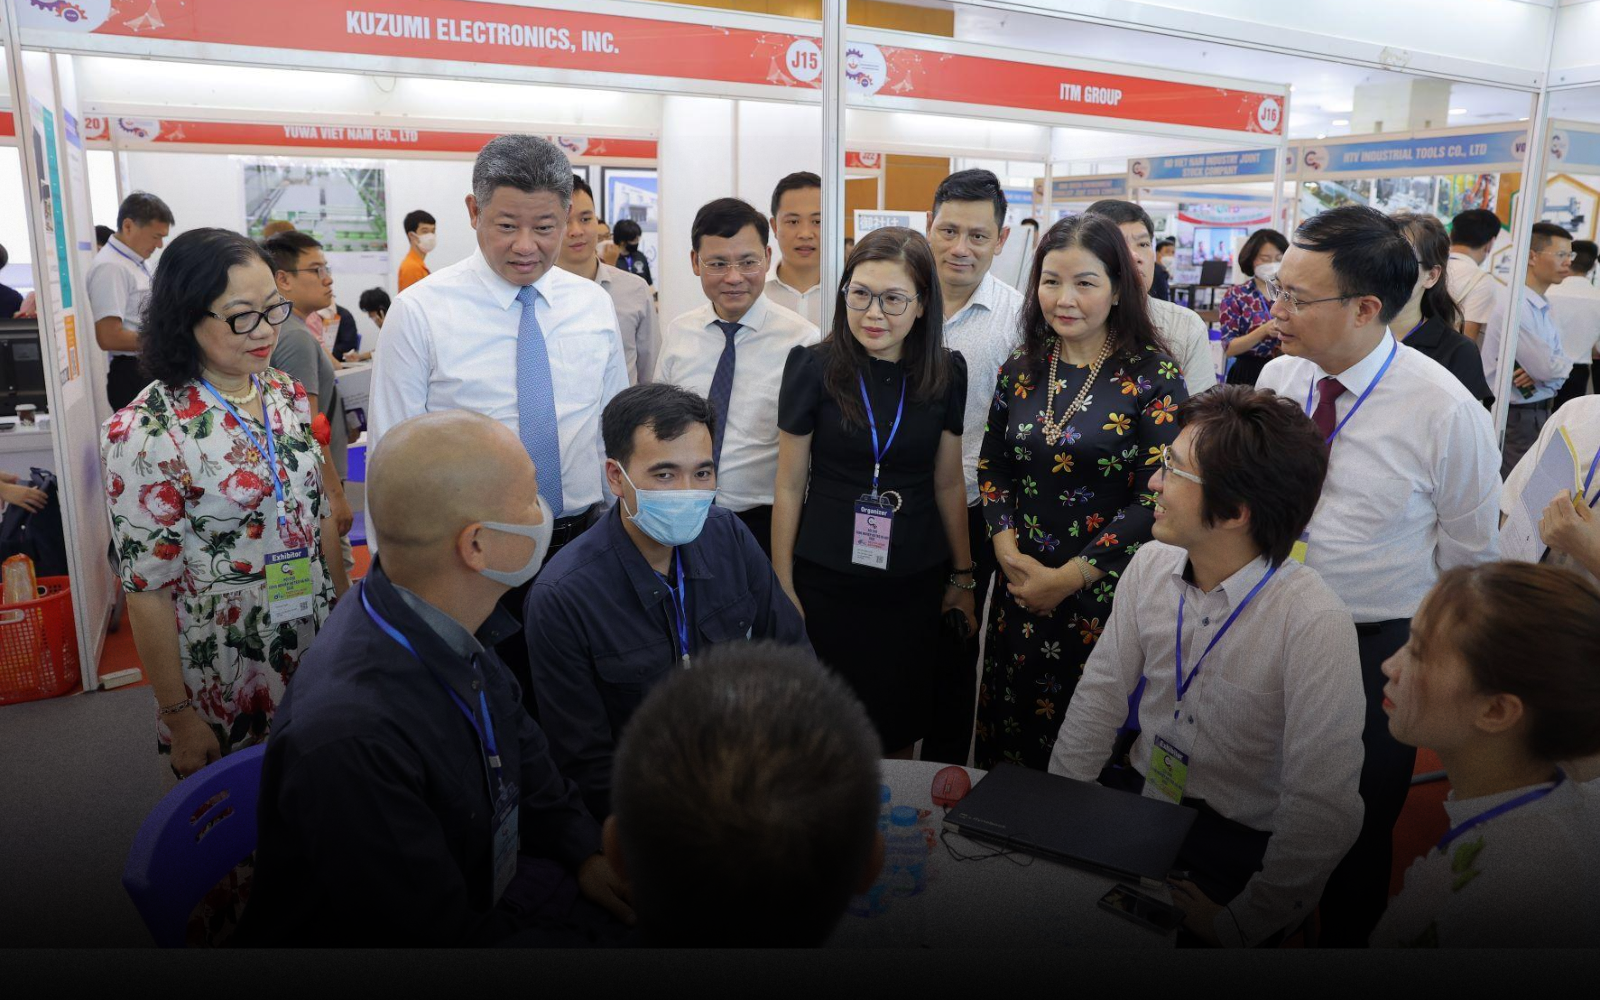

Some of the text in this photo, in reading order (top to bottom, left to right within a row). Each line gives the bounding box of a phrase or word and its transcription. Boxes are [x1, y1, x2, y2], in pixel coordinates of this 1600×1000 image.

[346, 10, 620, 54] KUZUMI ELECTRONICS, INC.
[791, 50, 818, 70] J15
[1060, 83, 1123, 106] ITM GROUP
[1261, 107, 1277, 122] J16
[283, 125, 318, 140] YUWA
[320, 126, 344, 140] VIET
[346, 127, 374, 141] NAM
[399, 129, 419, 142] LTD
[1361, 148, 1413, 162] INDUSTRIAL
[1416, 146, 1446, 160] TOOLS
[1470, 143, 1488, 156] LTD
[1205, 165, 1238, 176] COMPANY
[860, 506, 888, 517] Organizer
[272, 551, 302, 562] Exhibitor
